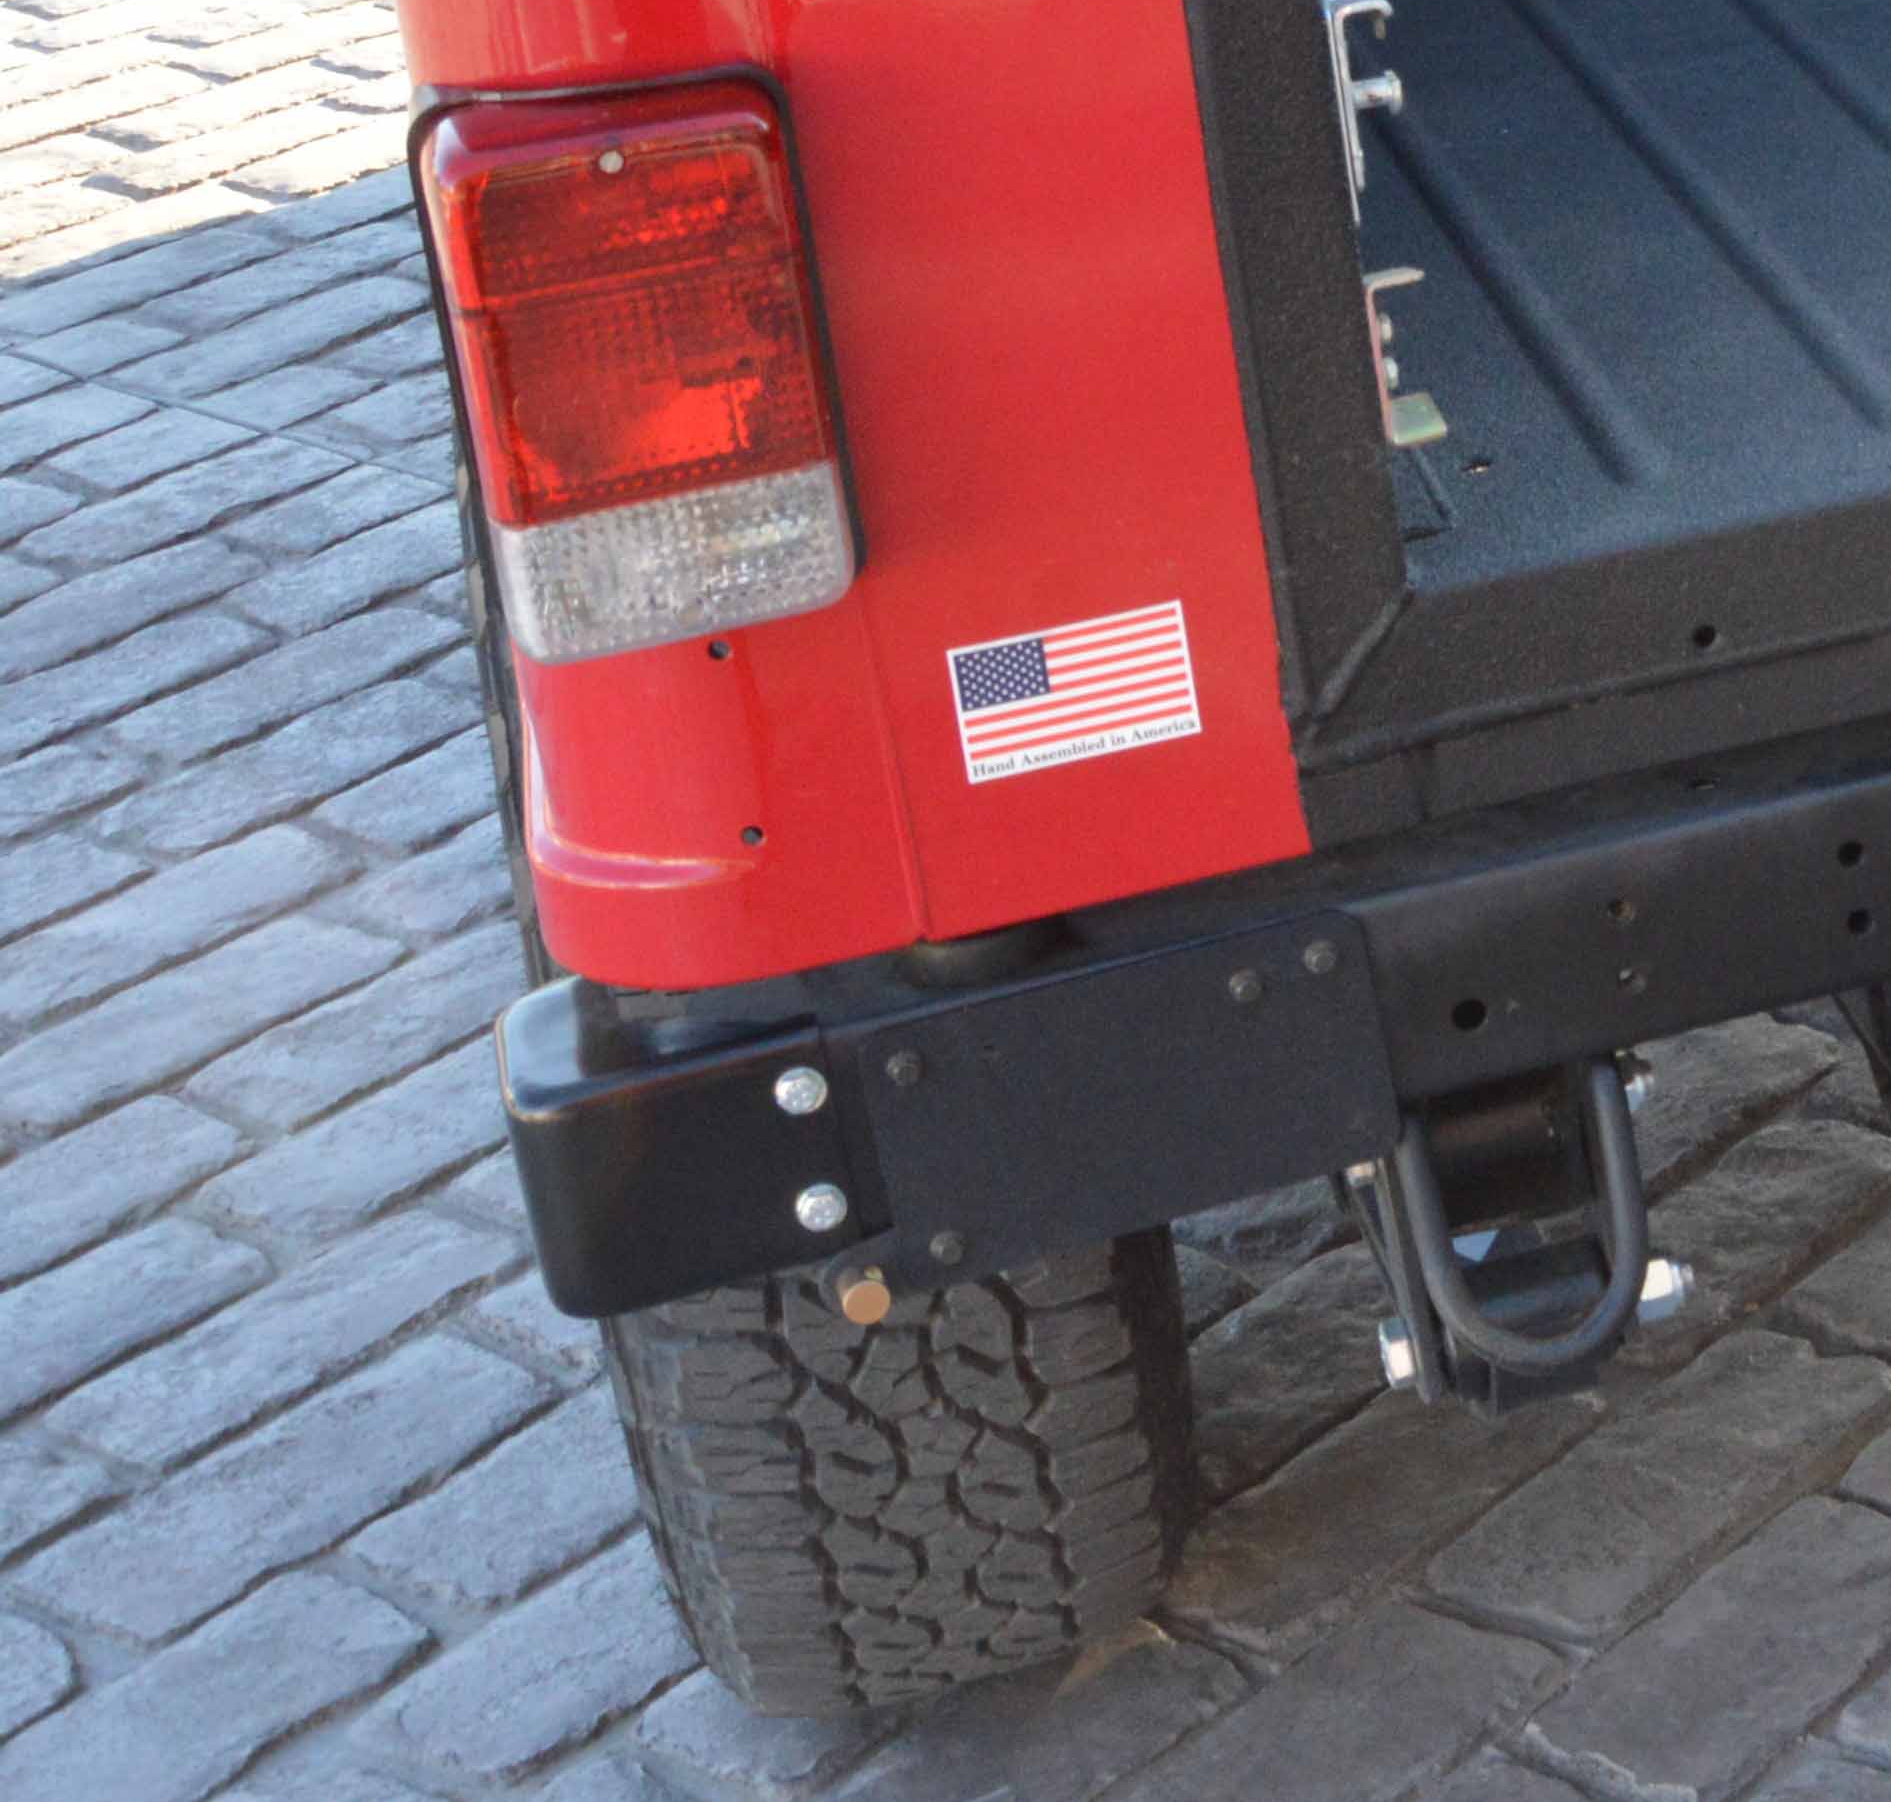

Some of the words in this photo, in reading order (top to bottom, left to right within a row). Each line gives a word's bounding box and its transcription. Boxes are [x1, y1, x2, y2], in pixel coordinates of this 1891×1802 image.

[972, 757, 1016, 778] Hand
[1021, 736, 1107, 767] Assembled
[1111, 732, 1128, 747] in
[1131, 718, 1197, 742] America
